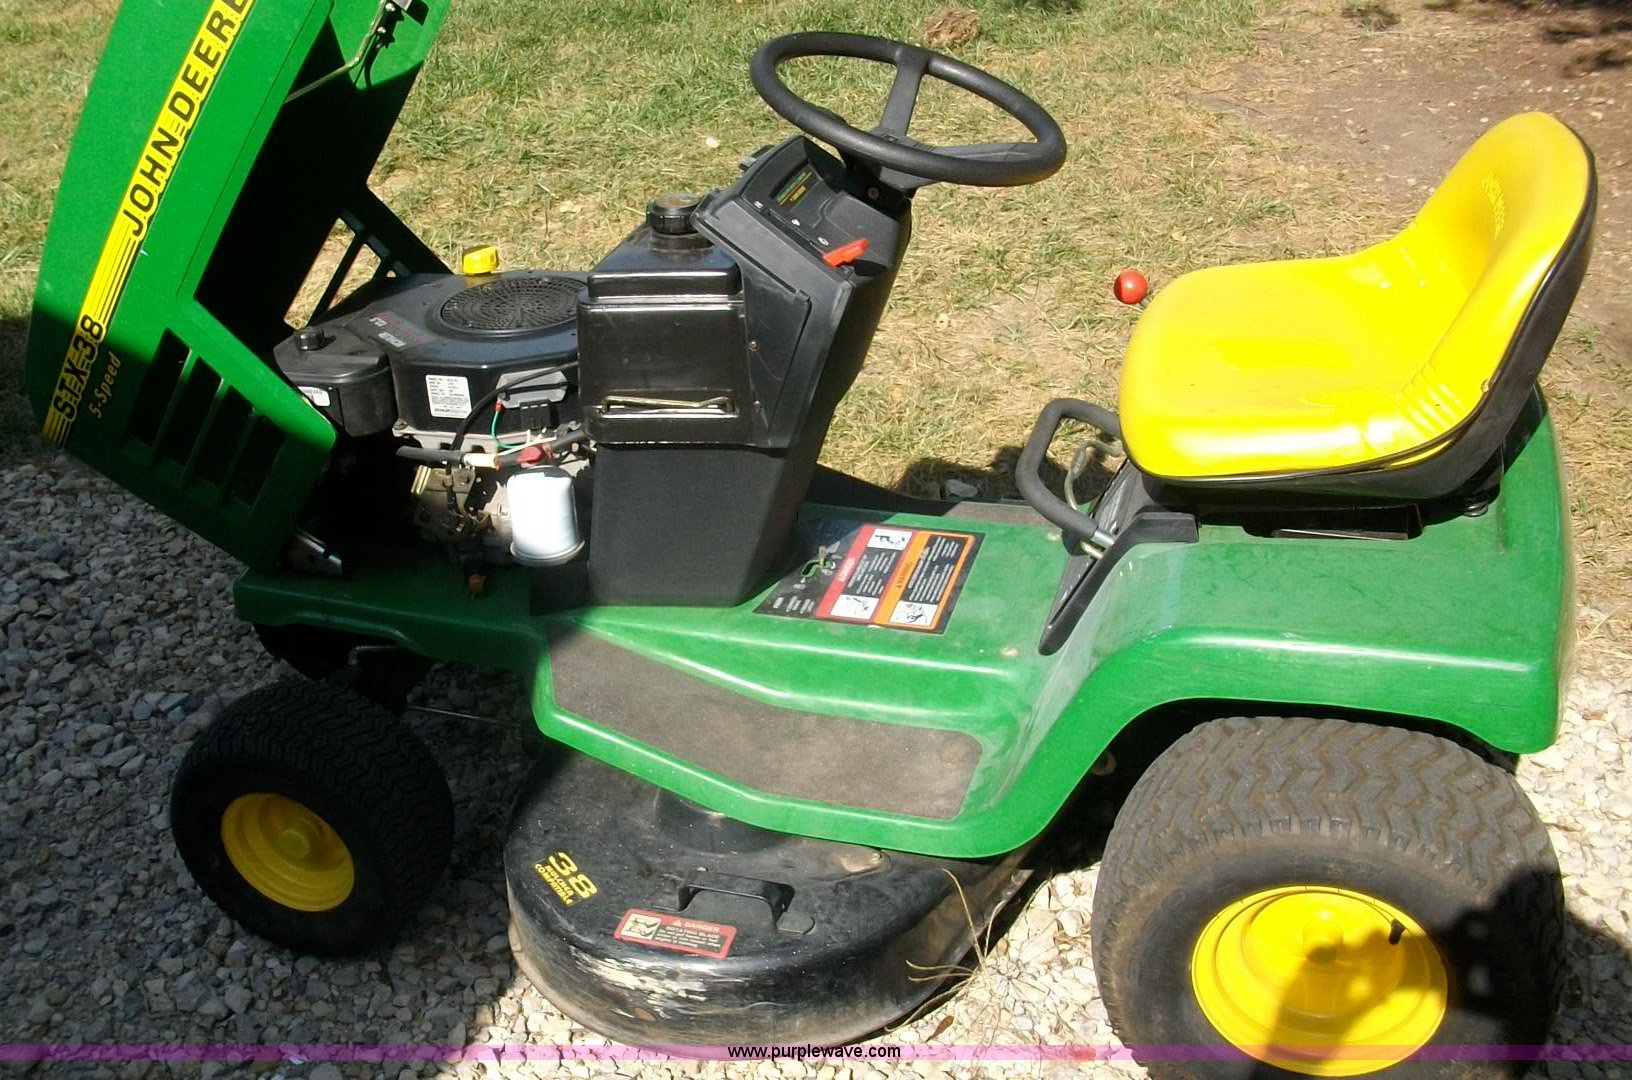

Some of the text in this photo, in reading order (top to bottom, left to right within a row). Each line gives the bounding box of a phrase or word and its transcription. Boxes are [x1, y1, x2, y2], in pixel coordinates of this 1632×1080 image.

[122, 127, 180, 237] JOHN
[53, 314, 104, 421] STX38
[89, 351, 121, 418] 5-Speed
[548, 852, 598, 899] 38
